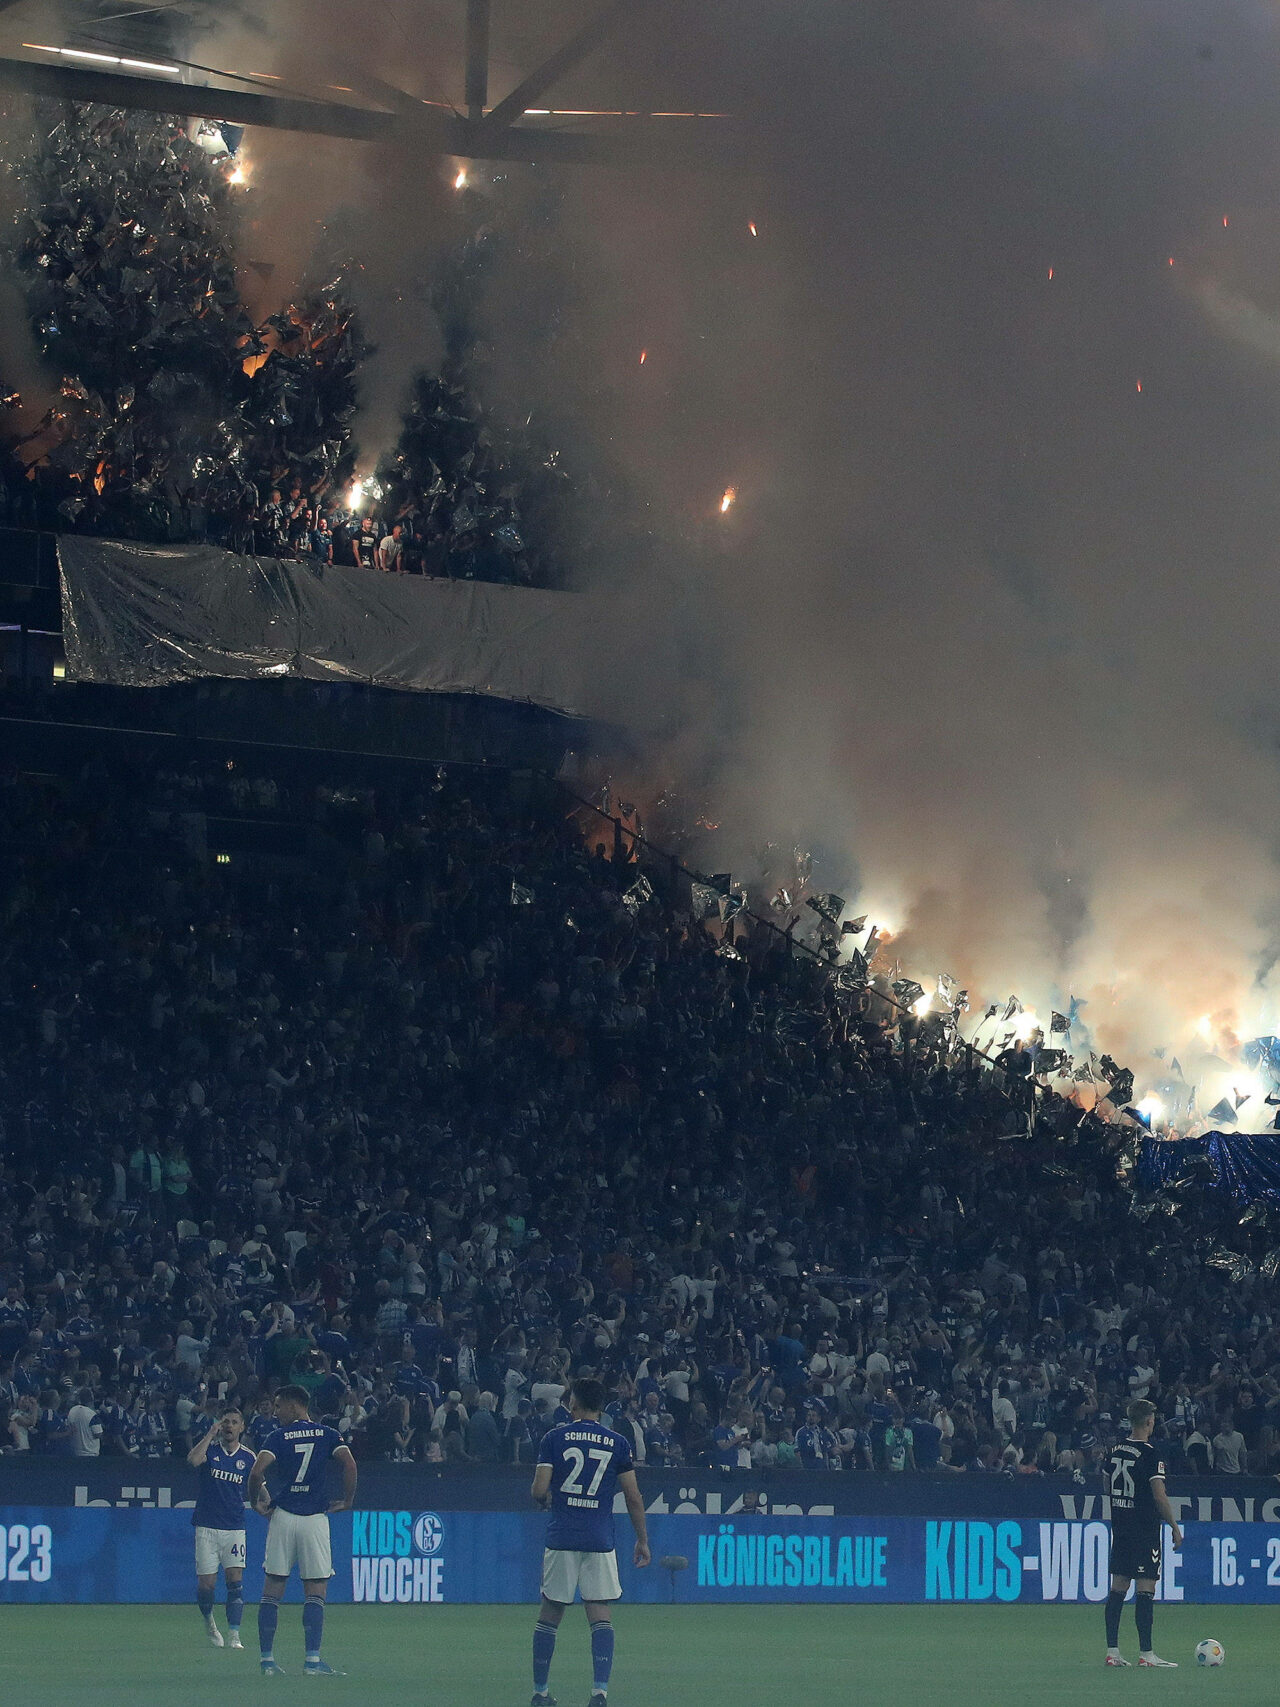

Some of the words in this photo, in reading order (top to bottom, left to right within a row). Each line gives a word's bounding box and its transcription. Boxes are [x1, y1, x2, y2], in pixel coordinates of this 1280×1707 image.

[284, 1430, 315, 1440] SCHALKE
[564, 1432, 602, 1443] SCHALKE
[603, 1436, 615, 1447] 04
[211, 1468, 244, 1484] VELTINS
[295, 1443, 315, 1483] 7
[560, 1447, 613, 1496] 27
[352, 1511, 413, 1556] KIDS
[352, 1557, 444, 1602] WOCHE
[697, 1524, 888, 1587] KÖNIGSBLAUE
[925, 1520, 1185, 1601] KIDS-WOE
[1211, 1537, 1245, 1586] 16.
